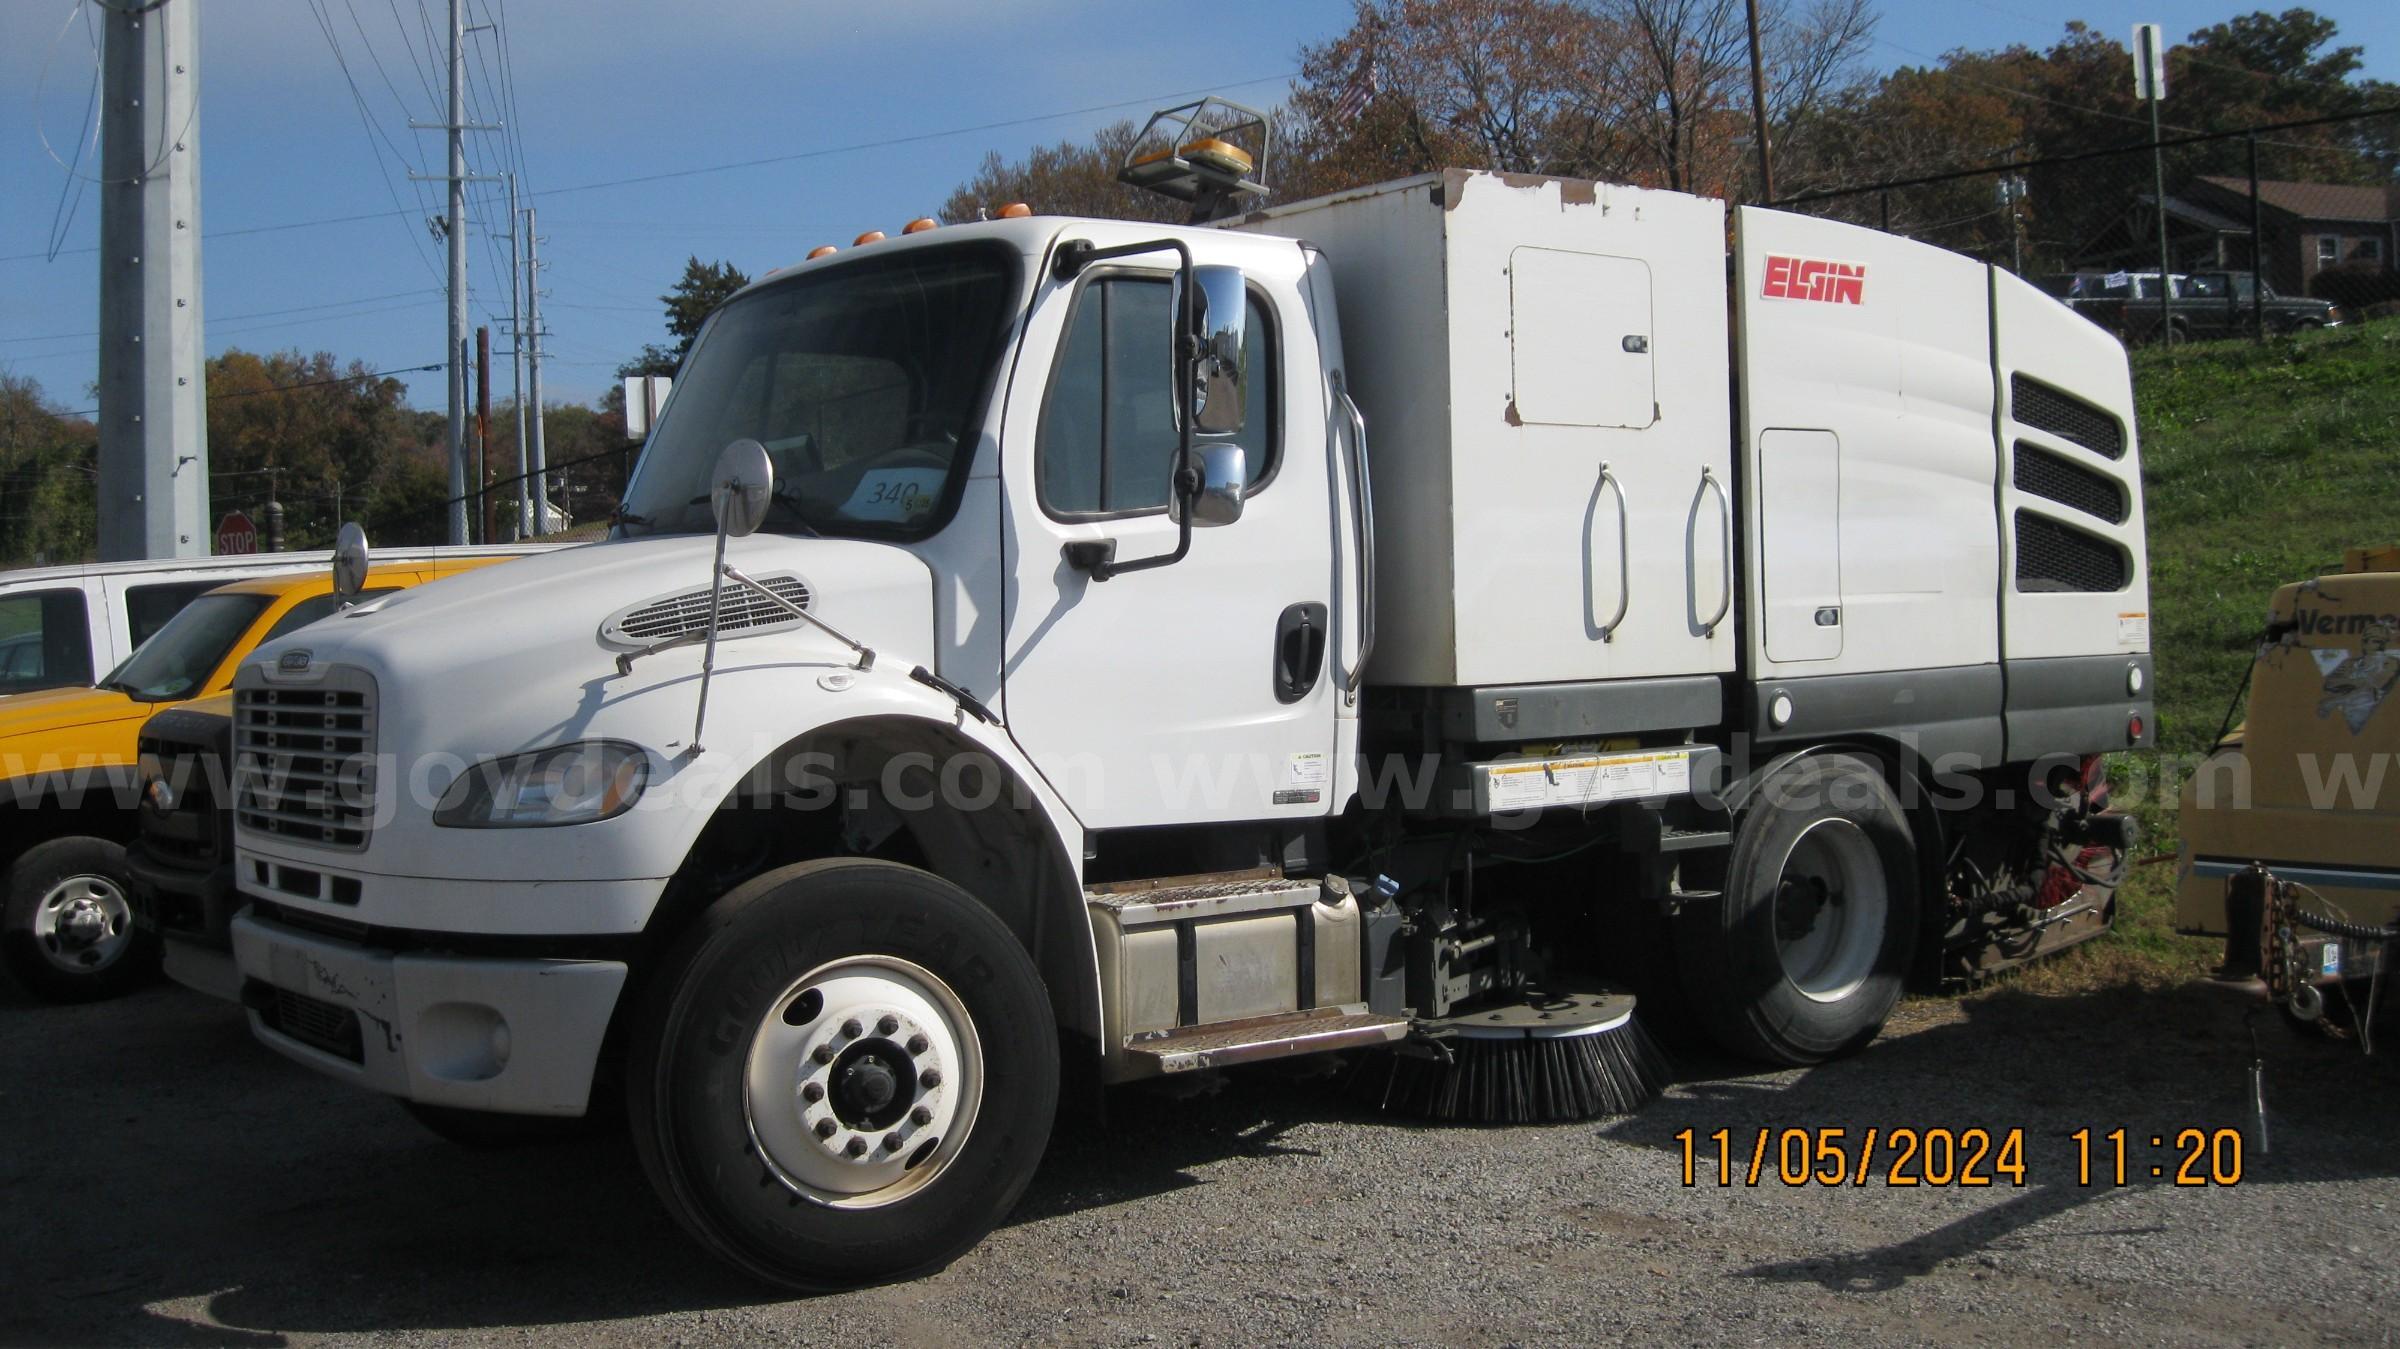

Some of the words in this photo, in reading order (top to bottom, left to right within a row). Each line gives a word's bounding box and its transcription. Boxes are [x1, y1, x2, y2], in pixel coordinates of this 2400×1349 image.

[1763, 256, 1865, 305] ELGIN
[866, 482, 919, 504] 340
[220, 530, 254, 554] STOP
